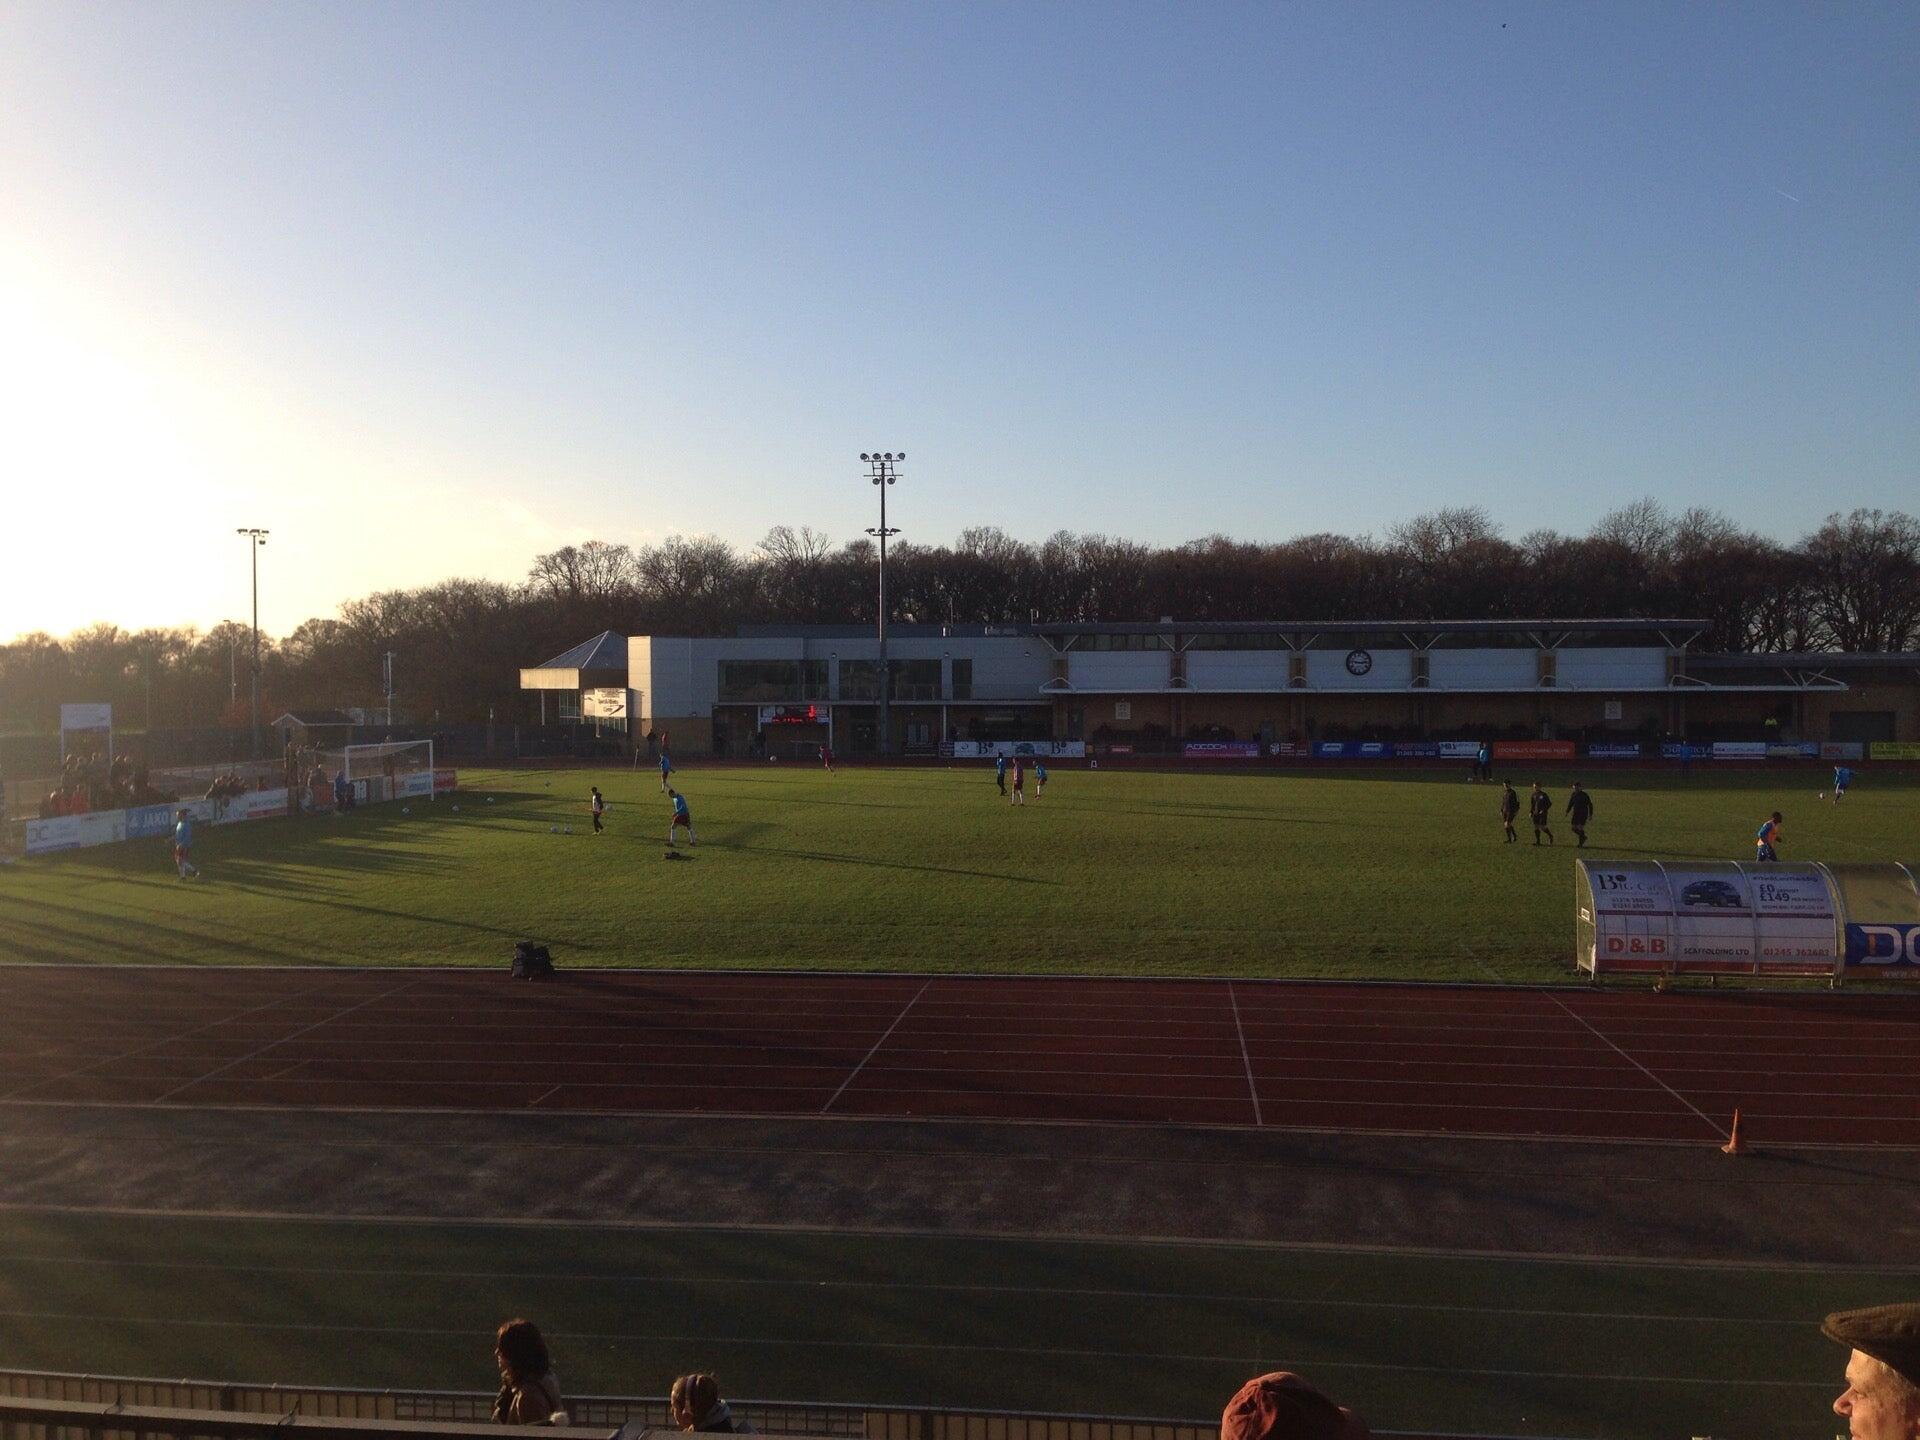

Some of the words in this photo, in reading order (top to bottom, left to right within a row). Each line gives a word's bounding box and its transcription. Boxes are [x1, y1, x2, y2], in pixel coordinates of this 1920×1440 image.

[1759, 883, 1775, 893] £0
[1759, 892, 1790, 902] £149
[1683, 947, 1734, 956] SCAFFOLDING
[1735, 947, 1750, 956] LTD
[1763, 948, 1792, 956] 01245
